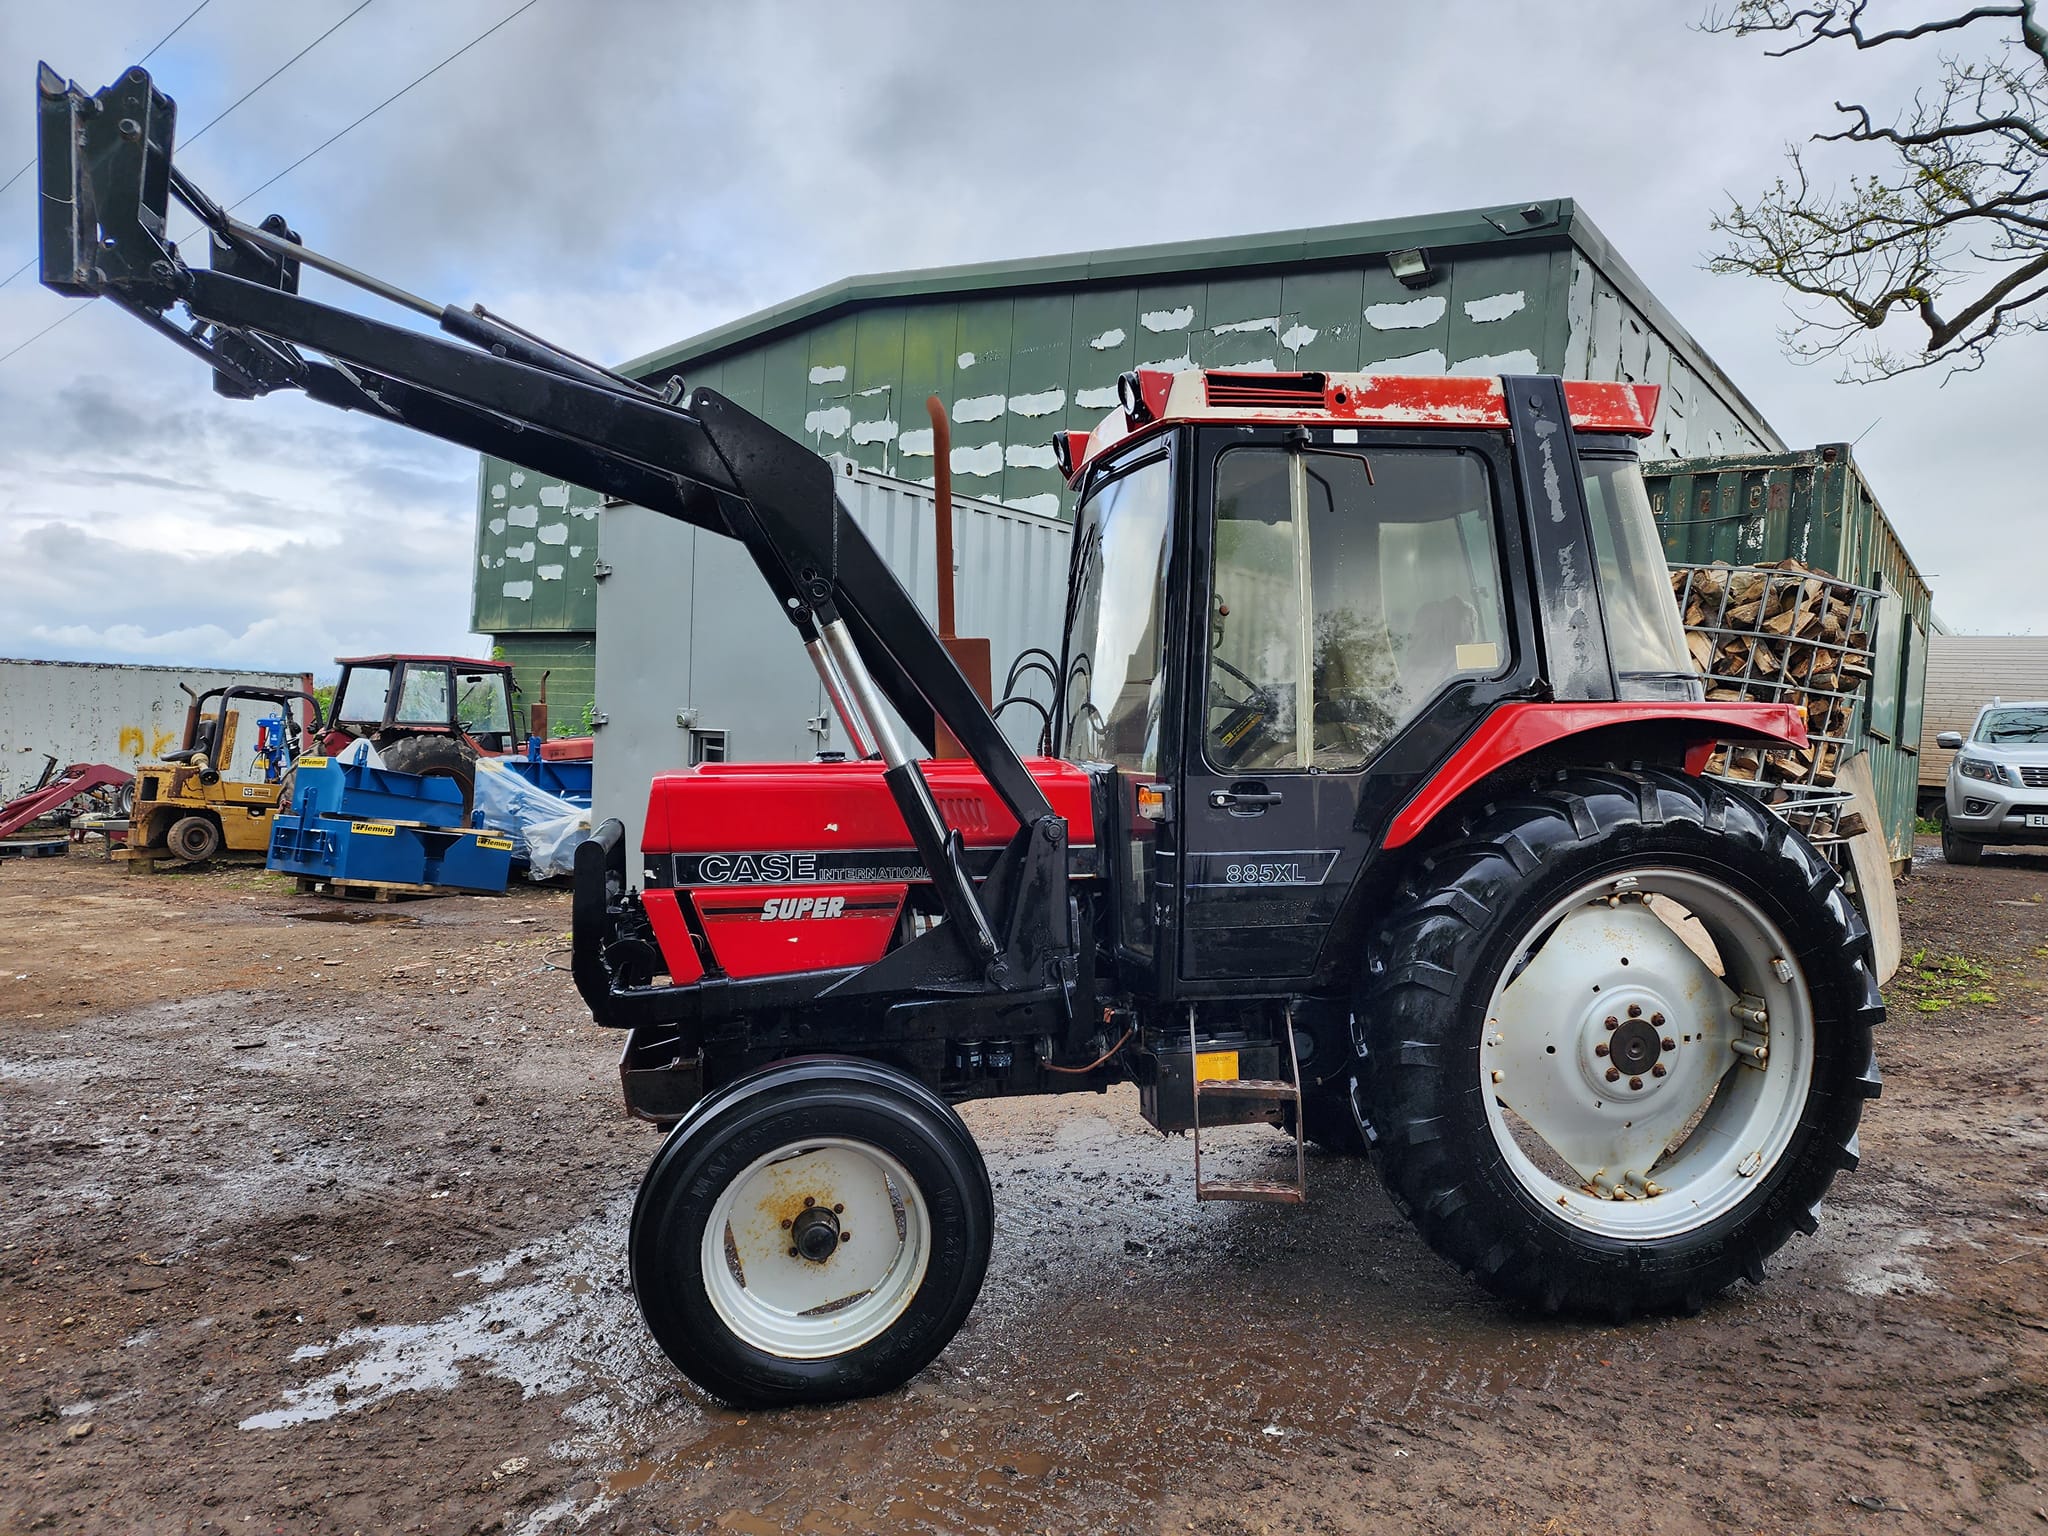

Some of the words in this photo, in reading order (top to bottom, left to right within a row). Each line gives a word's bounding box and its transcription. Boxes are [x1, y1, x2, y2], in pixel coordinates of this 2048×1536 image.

[360, 823, 394, 835] Fleming
[698, 853, 817, 883] CASE
[1226, 863, 1306, 883] 885XL
[760, 896, 846, 921] SUPER
